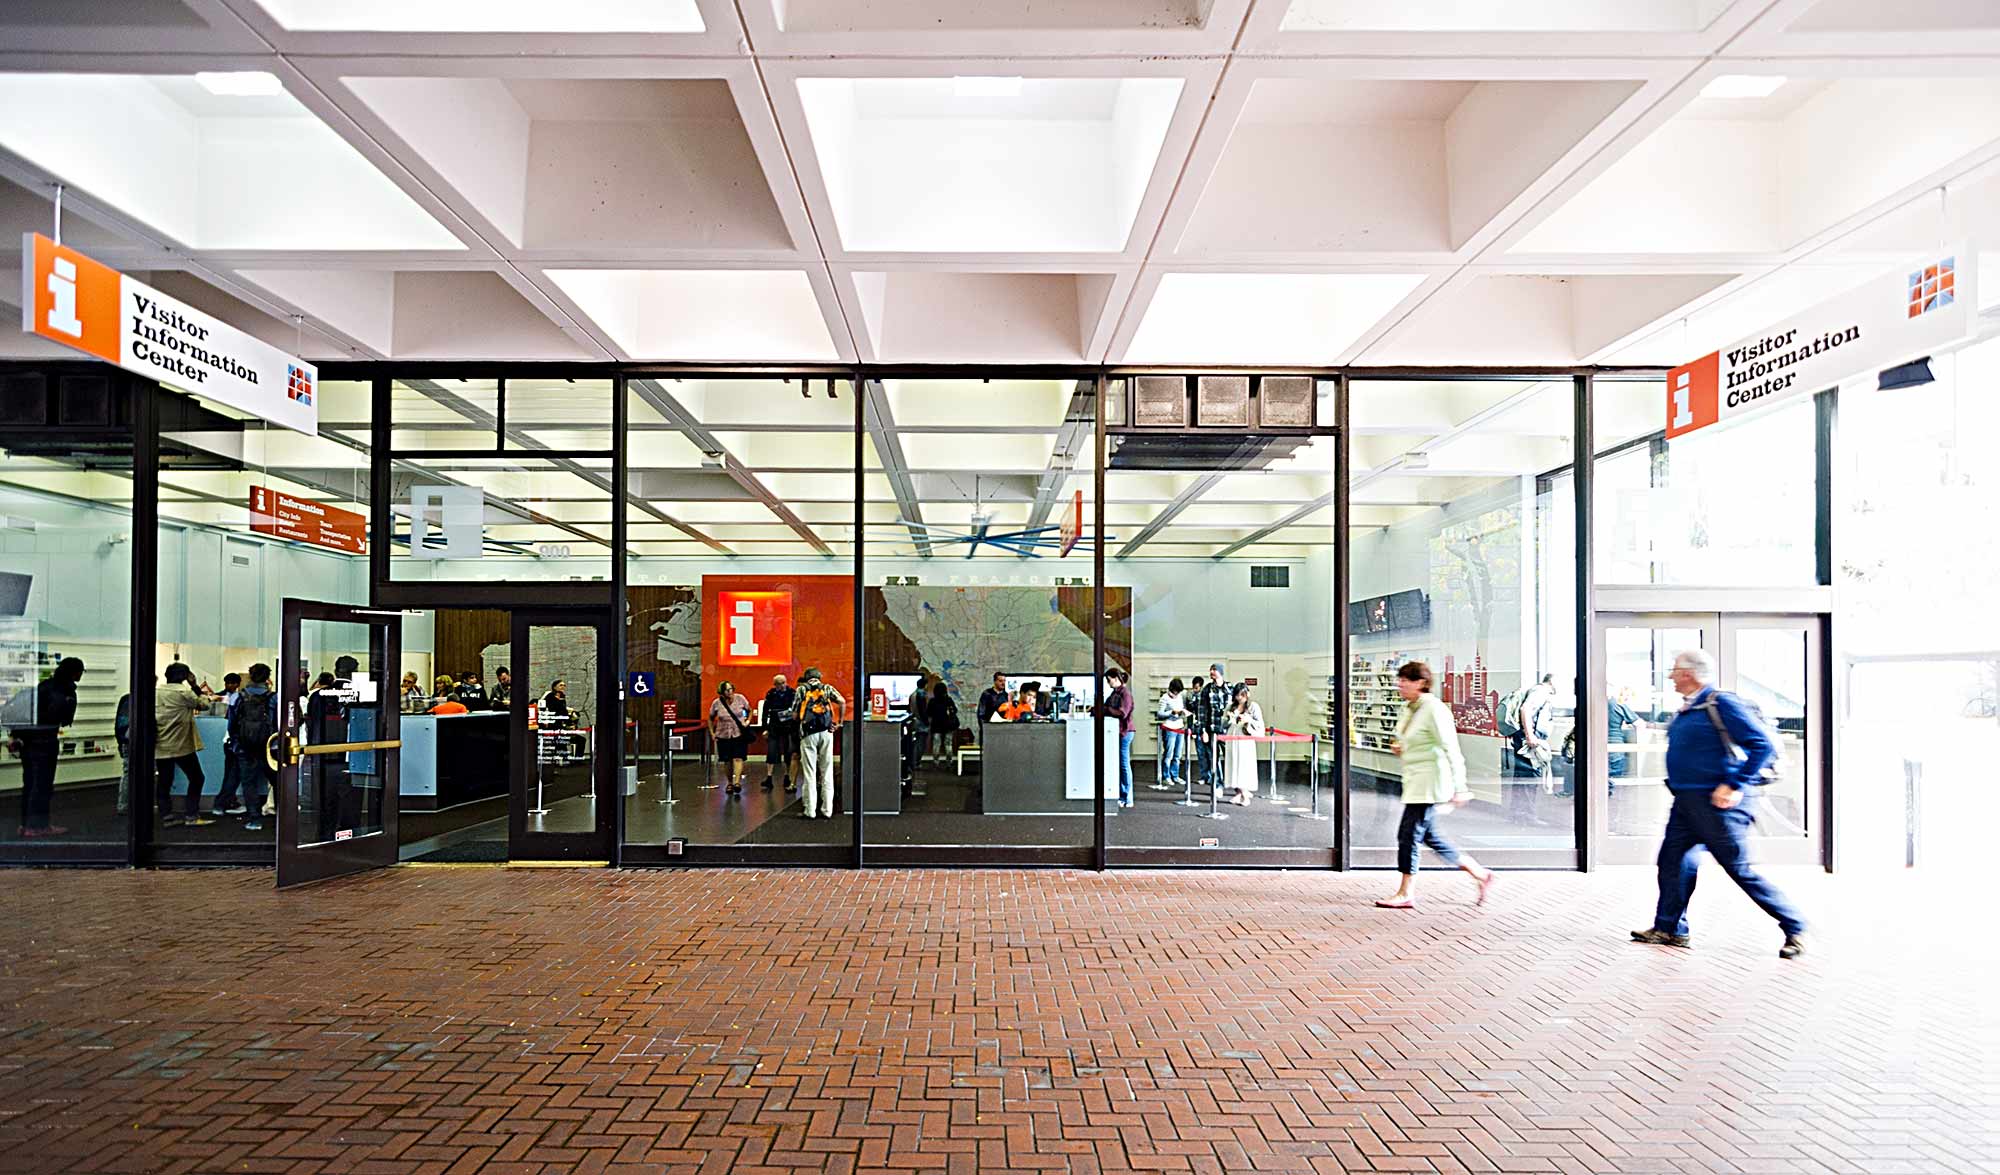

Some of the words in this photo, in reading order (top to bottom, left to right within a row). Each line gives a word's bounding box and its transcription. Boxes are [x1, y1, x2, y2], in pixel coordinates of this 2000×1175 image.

[48, 256, 82, 338] i
[132, 292, 209, 341] Visitor
[132, 315, 259, 385] Information
[132, 340, 208, 383] Center
[1726, 329, 1797, 368] Visitor
[1726, 325, 1861, 389] Information
[1673, 371, 1693, 430] i
[1726, 371, 1797, 408] Center
[257, 489, 266, 511] i
[279, 496, 325, 516] Information
[730, 600, 759, 656] i
